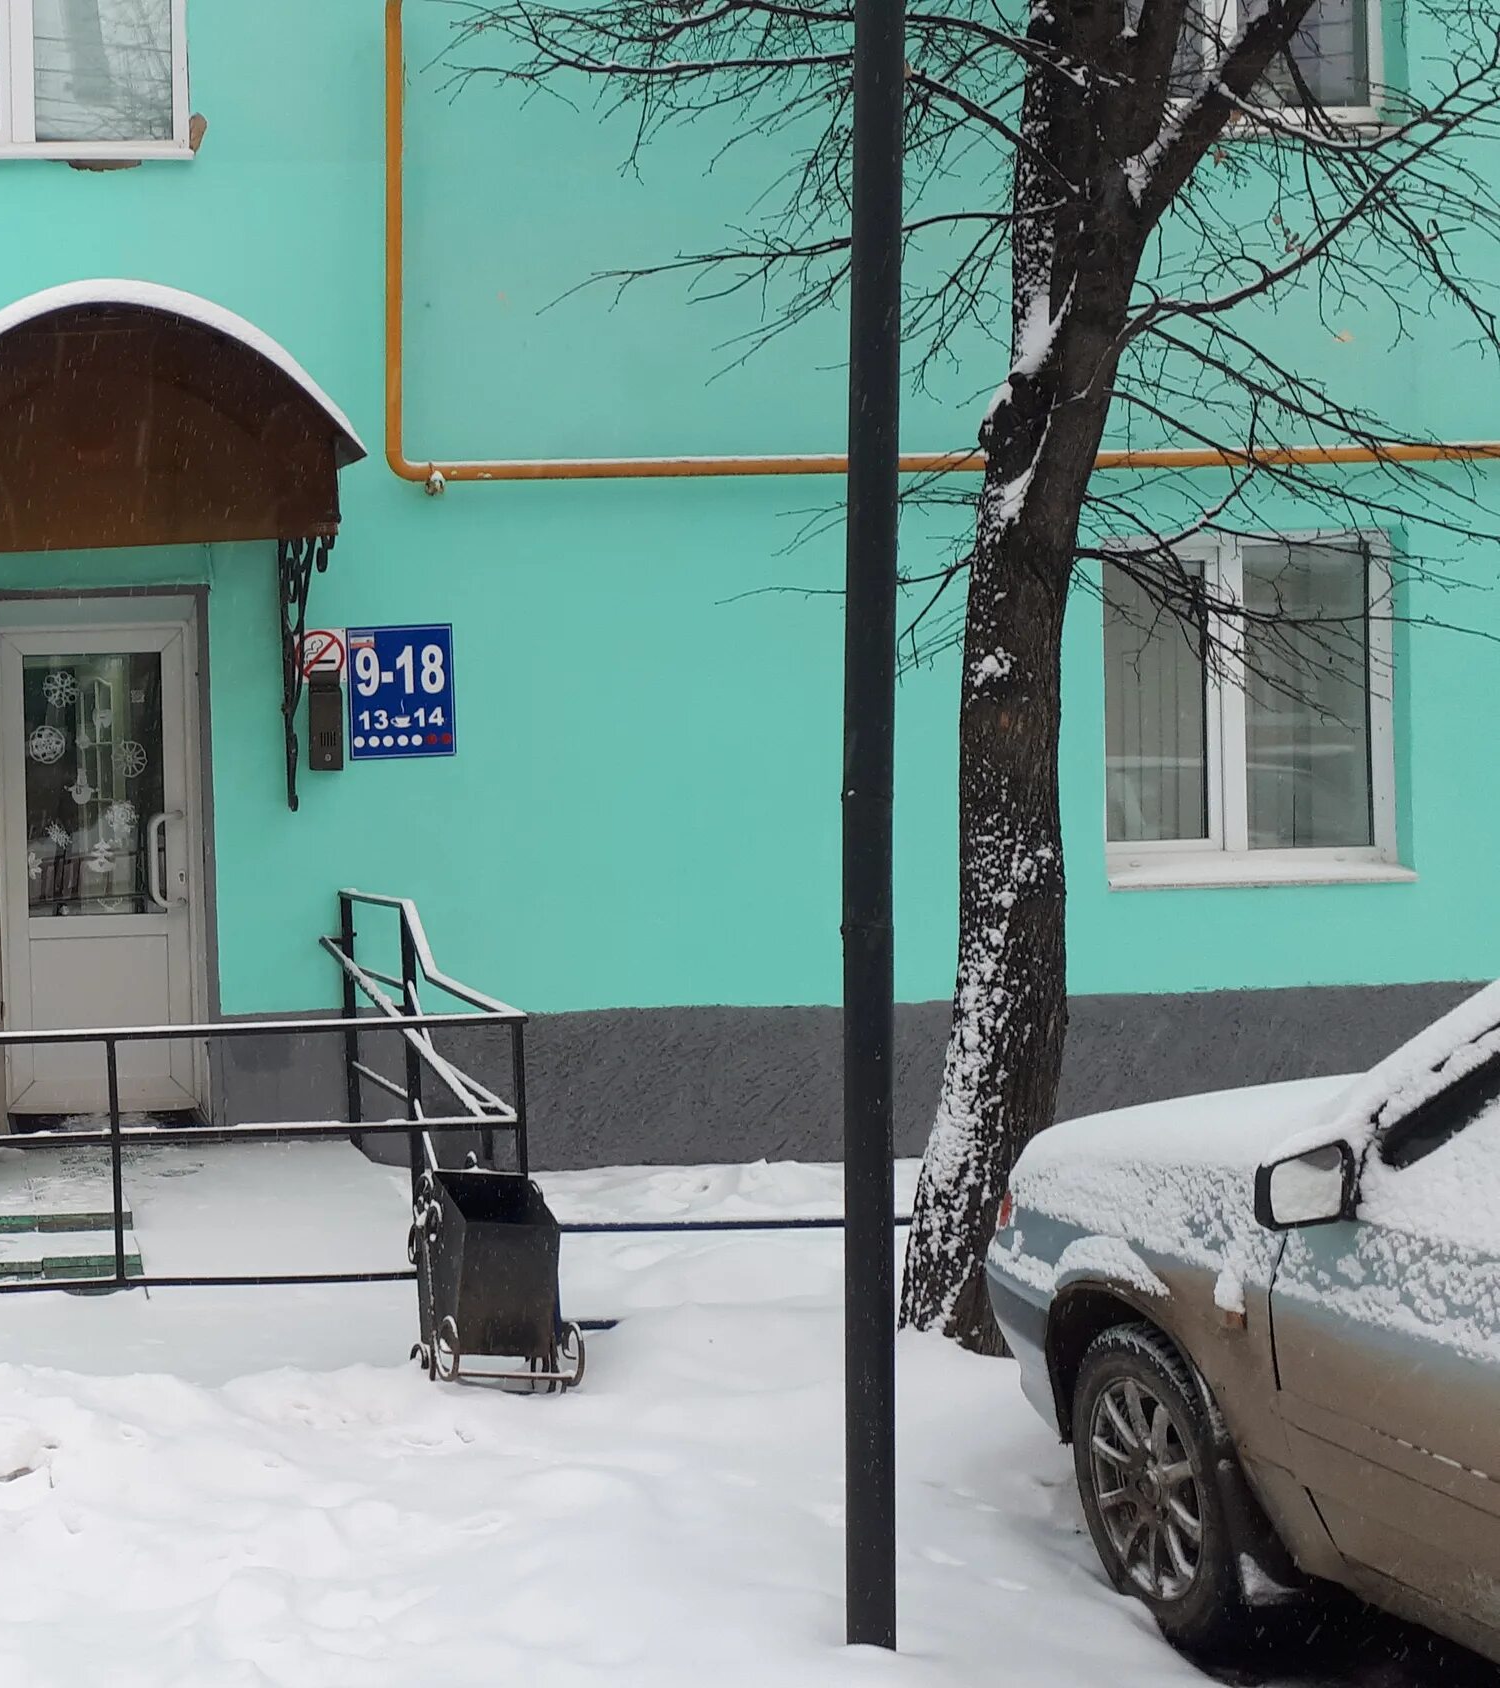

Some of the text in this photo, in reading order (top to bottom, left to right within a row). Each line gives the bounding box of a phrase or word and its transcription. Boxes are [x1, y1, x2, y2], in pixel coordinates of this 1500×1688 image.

[355, 644, 445, 696] 9-18
[358, 706, 445, 730] 13 14
